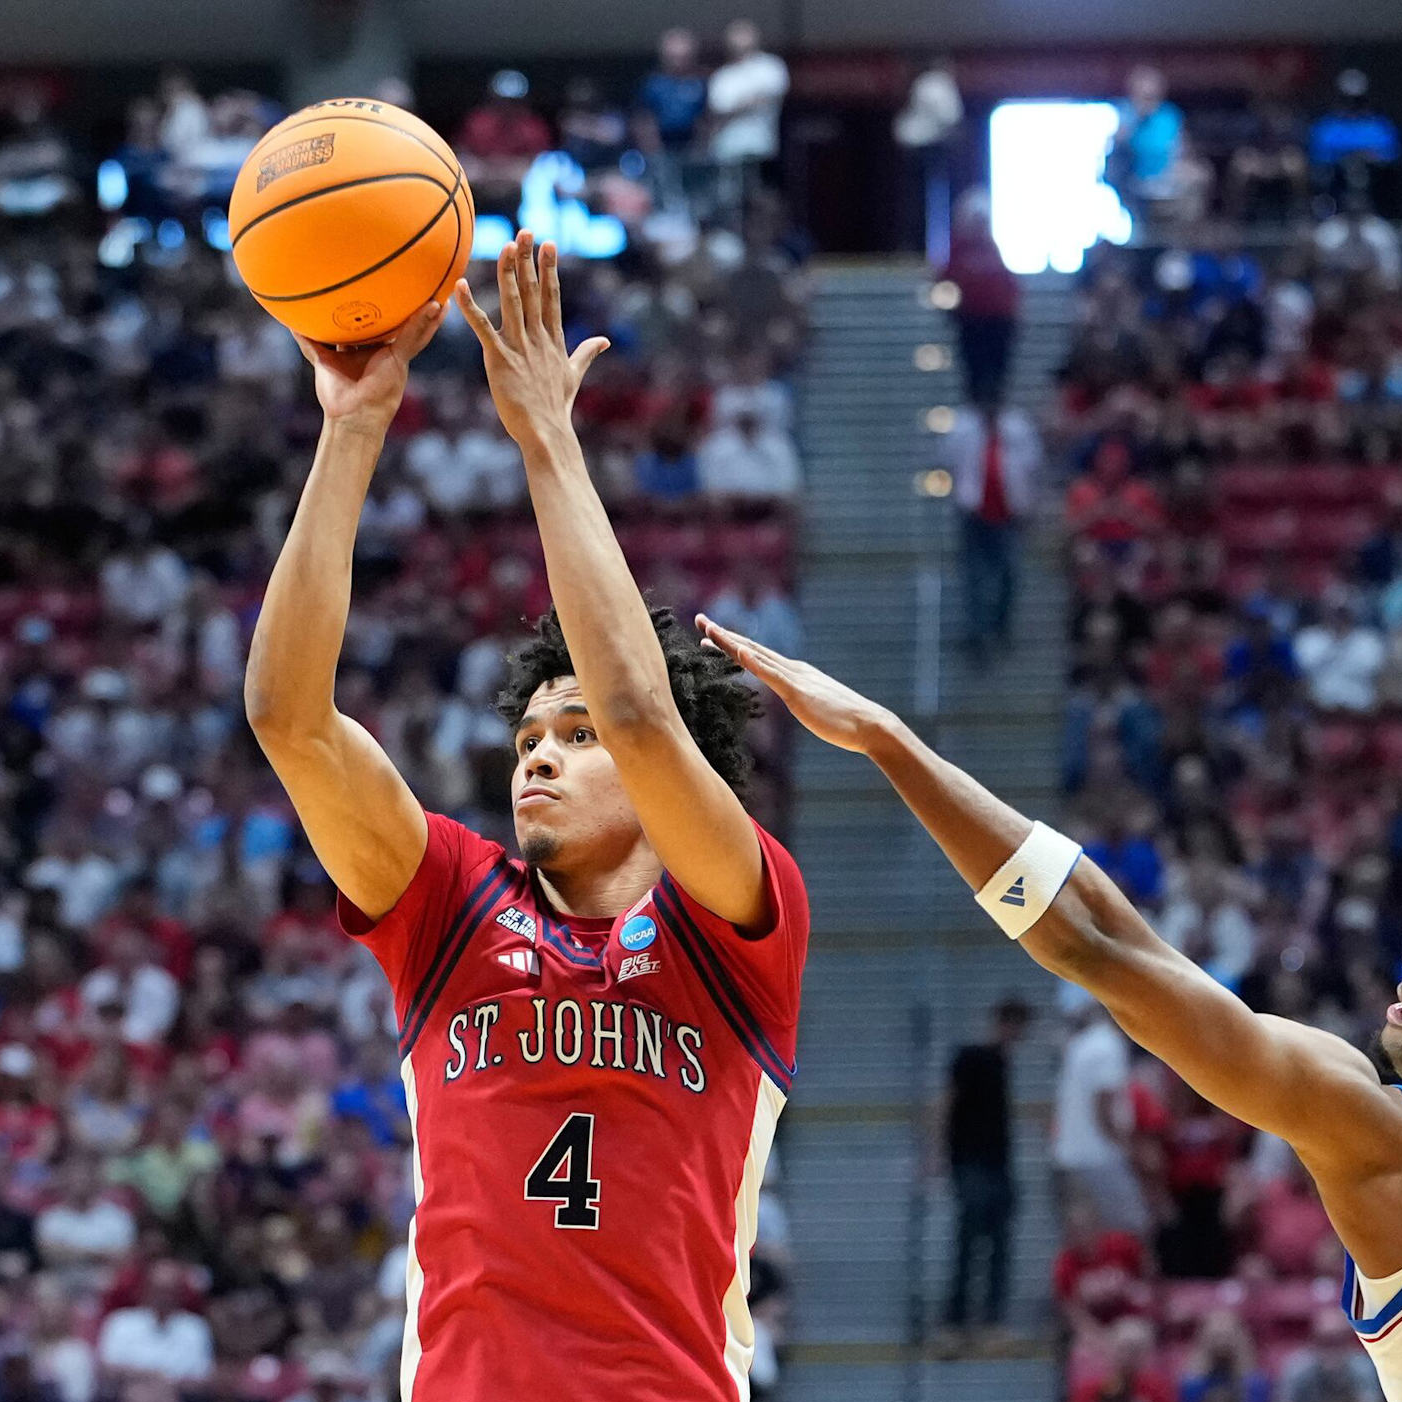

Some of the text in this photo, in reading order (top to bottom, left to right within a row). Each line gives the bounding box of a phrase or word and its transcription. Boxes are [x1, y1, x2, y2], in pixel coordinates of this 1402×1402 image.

[276, 144, 333, 172] MADNESS
[495, 913, 536, 943] CHANG
[504, 907, 537, 932] BE TH
[624, 927, 655, 945] NCAA
[618, 960, 661, 981] EAST
[621, 953, 650, 969] BIG
[445, 998, 707, 1093] ST. JOHN'S
[524, 1112, 601, 1230] 4
